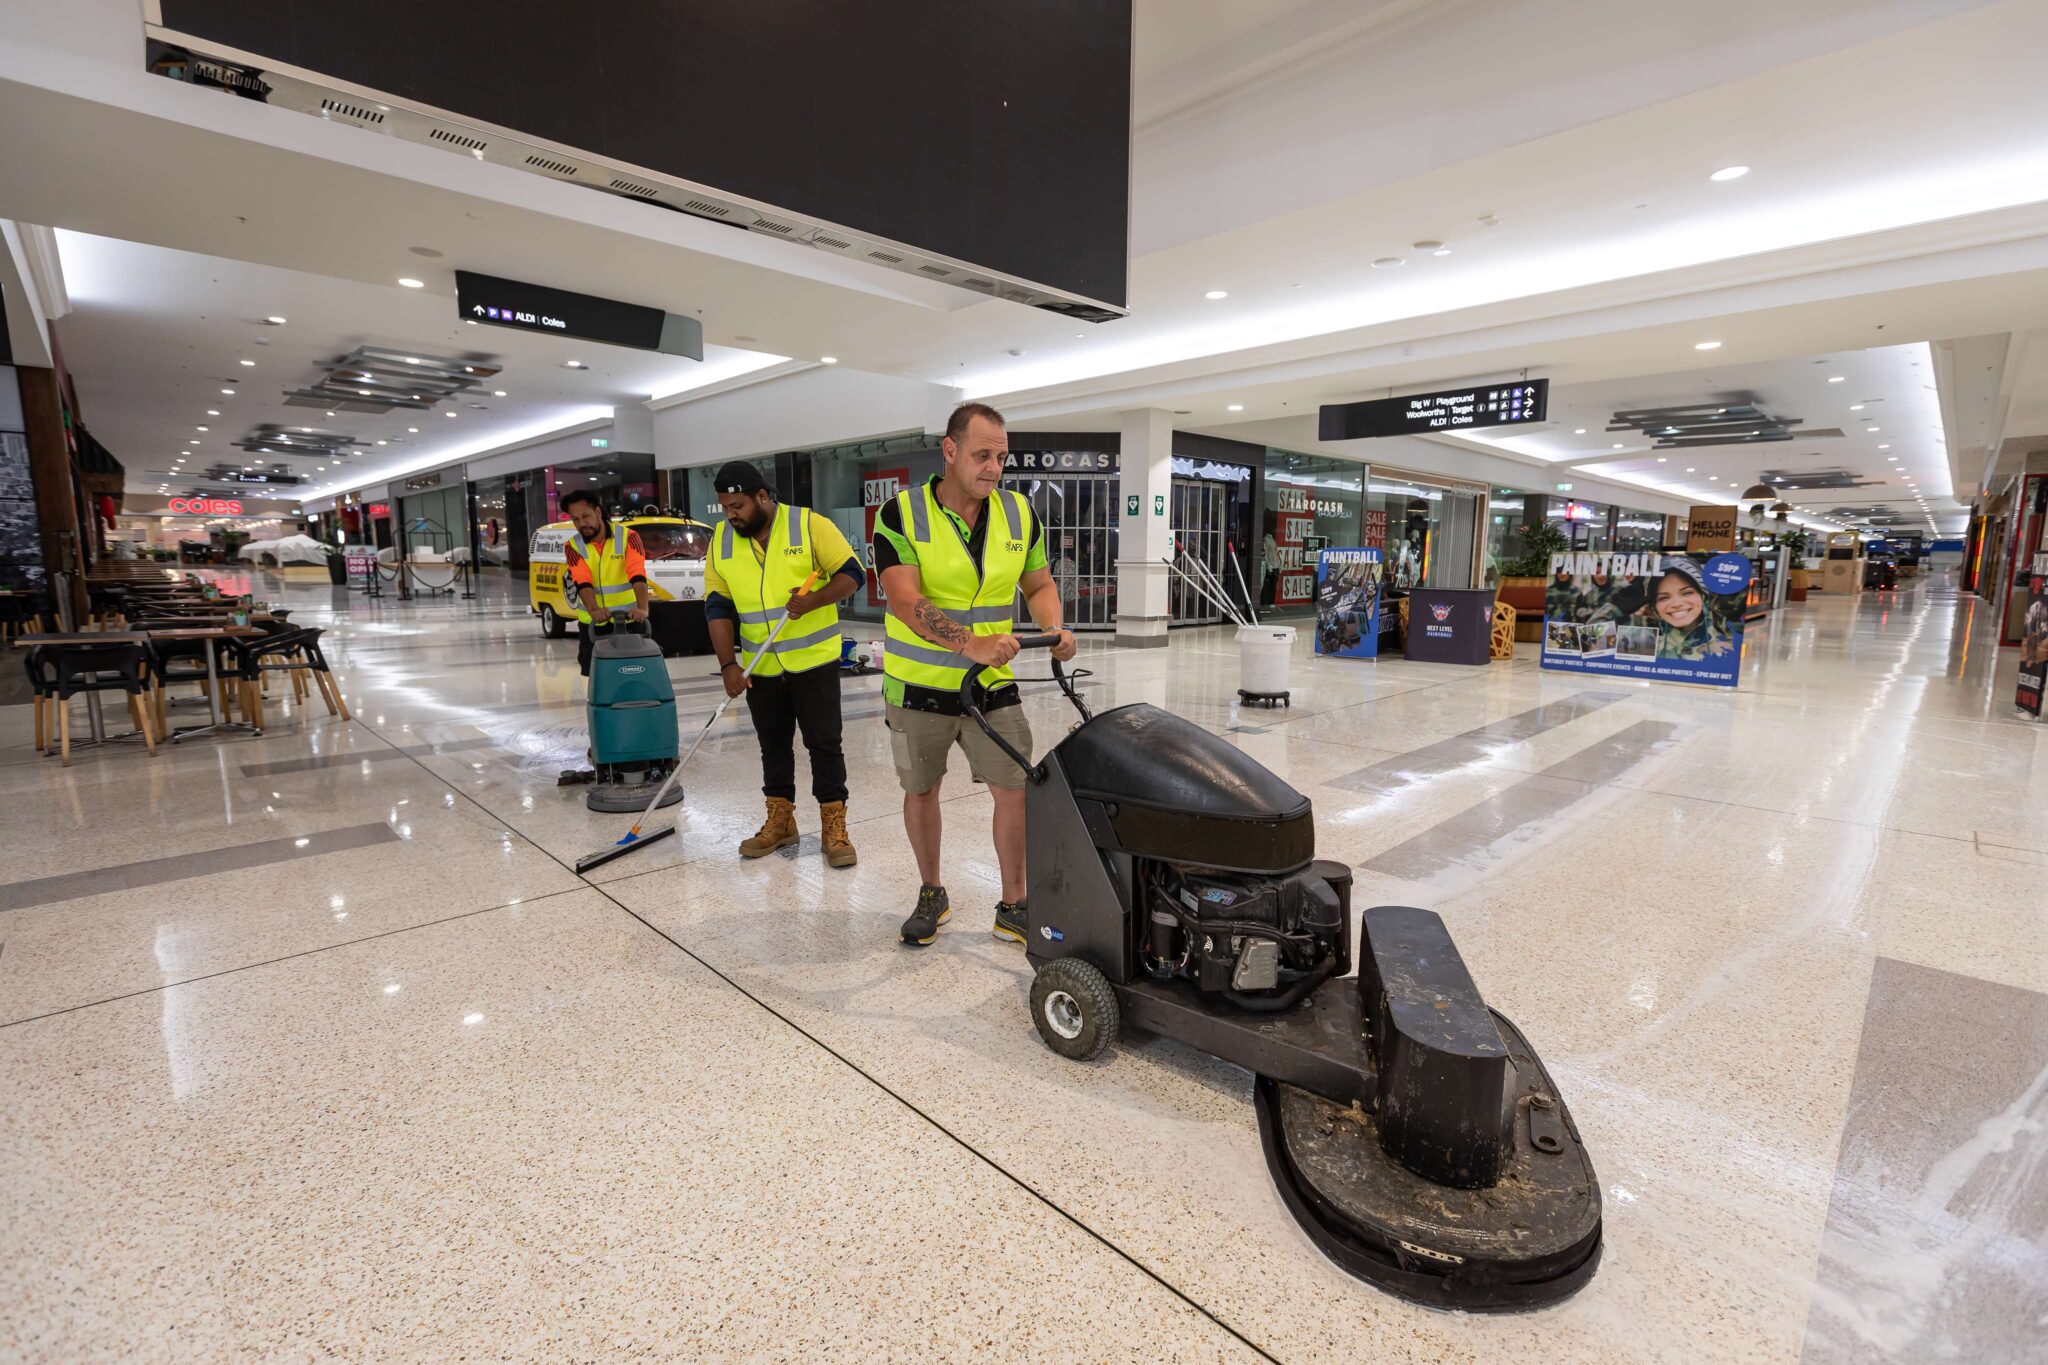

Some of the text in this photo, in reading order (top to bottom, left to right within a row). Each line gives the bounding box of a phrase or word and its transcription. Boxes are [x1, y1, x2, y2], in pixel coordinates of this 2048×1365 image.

[515, 312, 536, 323] ALDI
[541, 316, 566, 329] Coles
[1411, 394, 1475, 409] Big W Playground
[1406, 405, 1474, 419] Woolworths Target
[1430, 417, 1447, 427] ALDI
[1451, 416, 1473, 425] Coles
[1005, 453, 1121, 468] AROCAS
[866, 480, 898, 503] SALE
[707, 504, 723, 514] TAR
[1289, 498, 1343, 513] TAROCASH
[1366, 511, 1387, 526] SALE
[1692, 520, 1732, 530] HELLO
[1286, 520, 1313, 541] SALE
[1365, 525, 1386, 540] SALE
[1691, 529, 1731, 539] PHONE
[1322, 550, 1379, 564] PAINTBALL
[1551, 554, 1666, 577] PAINTBALL
[1283, 577, 1312, 597] SALE
[1586, 661, 1612, 669] CORPORATE
[1612, 663, 1631, 671] EVENTS
[1671, 669, 1693, 677] PARTIES
